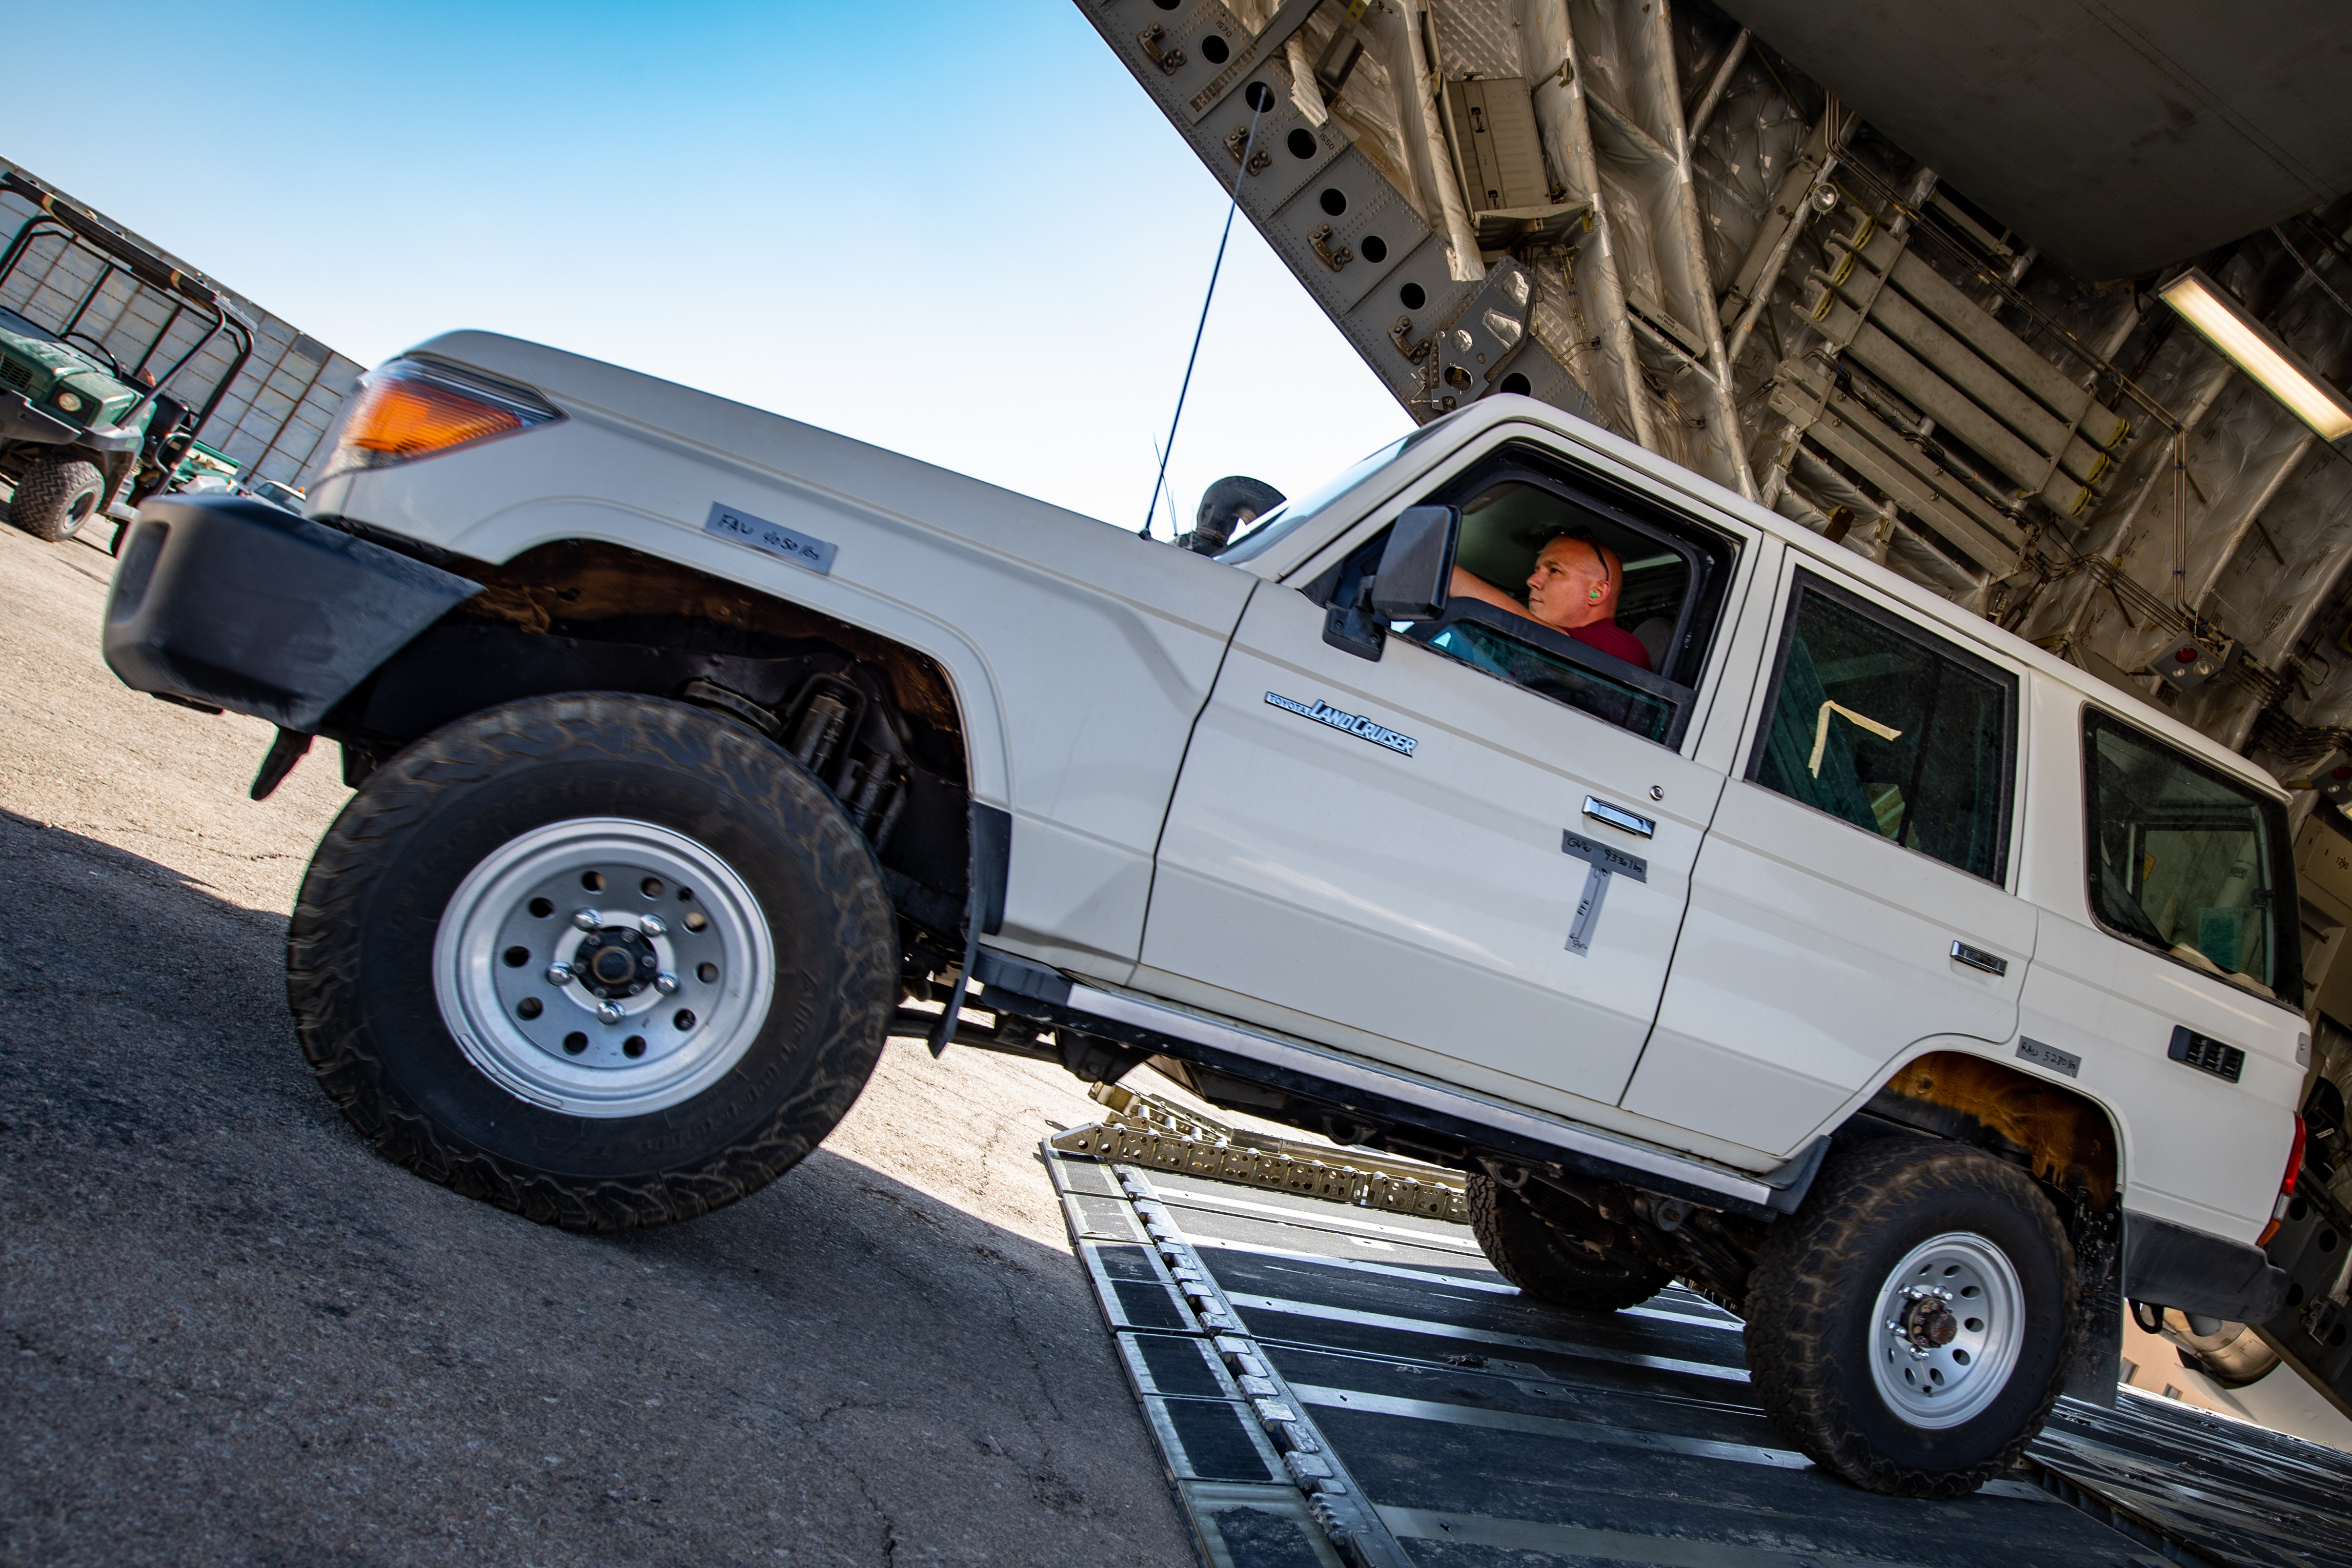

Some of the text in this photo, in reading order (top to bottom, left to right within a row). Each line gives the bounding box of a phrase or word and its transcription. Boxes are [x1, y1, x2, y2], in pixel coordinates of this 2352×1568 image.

[1215, 19, 1232, 37] 1570
[1319, 133, 1334, 150] 1550
[1664, 314, 1676, 325] STOWAGE
[1269, 695, 1307, 715] TOYOTA
[2336, 857, 2349, 870] 1290
